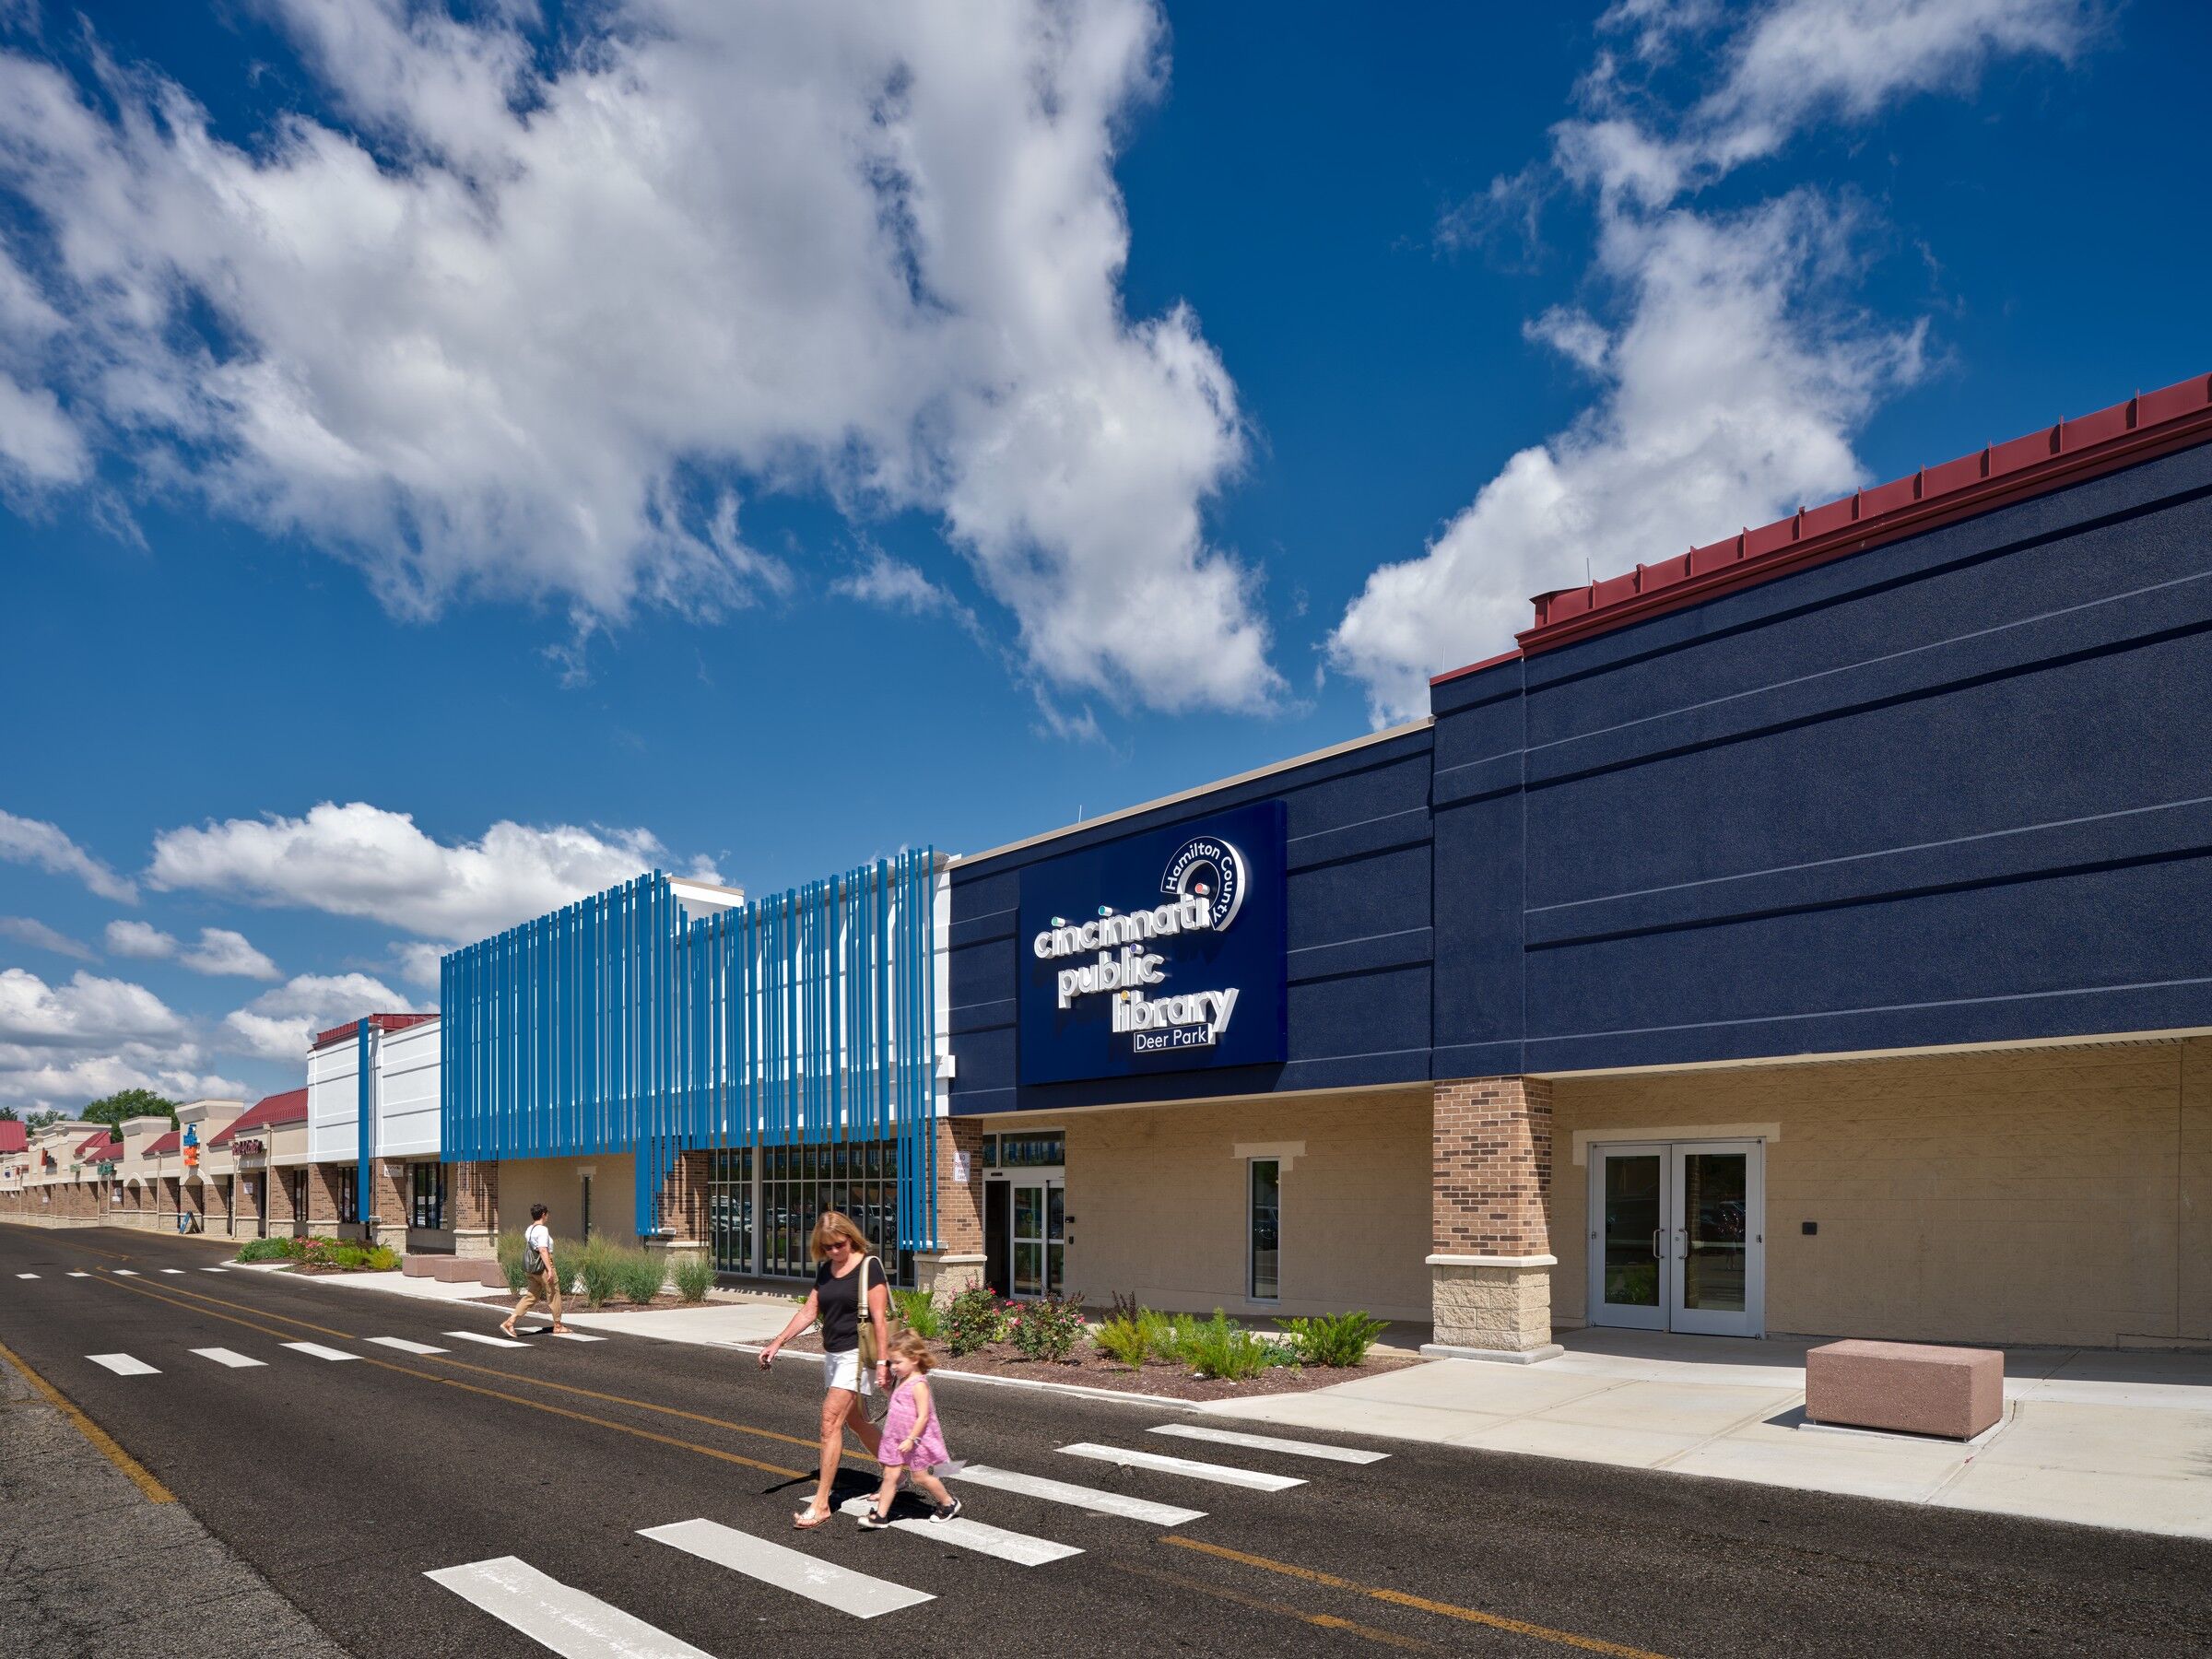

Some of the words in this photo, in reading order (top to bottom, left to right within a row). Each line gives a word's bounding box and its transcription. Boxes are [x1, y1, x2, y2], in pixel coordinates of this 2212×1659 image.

[1165, 842, 1220, 890] Hamilton
[1213, 856, 1233, 924] County
[1034, 882, 1210, 959] cincinnati
[1058, 943, 1165, 1009] public
[1112, 988, 1239, 1033] library
[1136, 1034, 1169, 1050] Deer
[1173, 1026, 1206, 1046] Park
